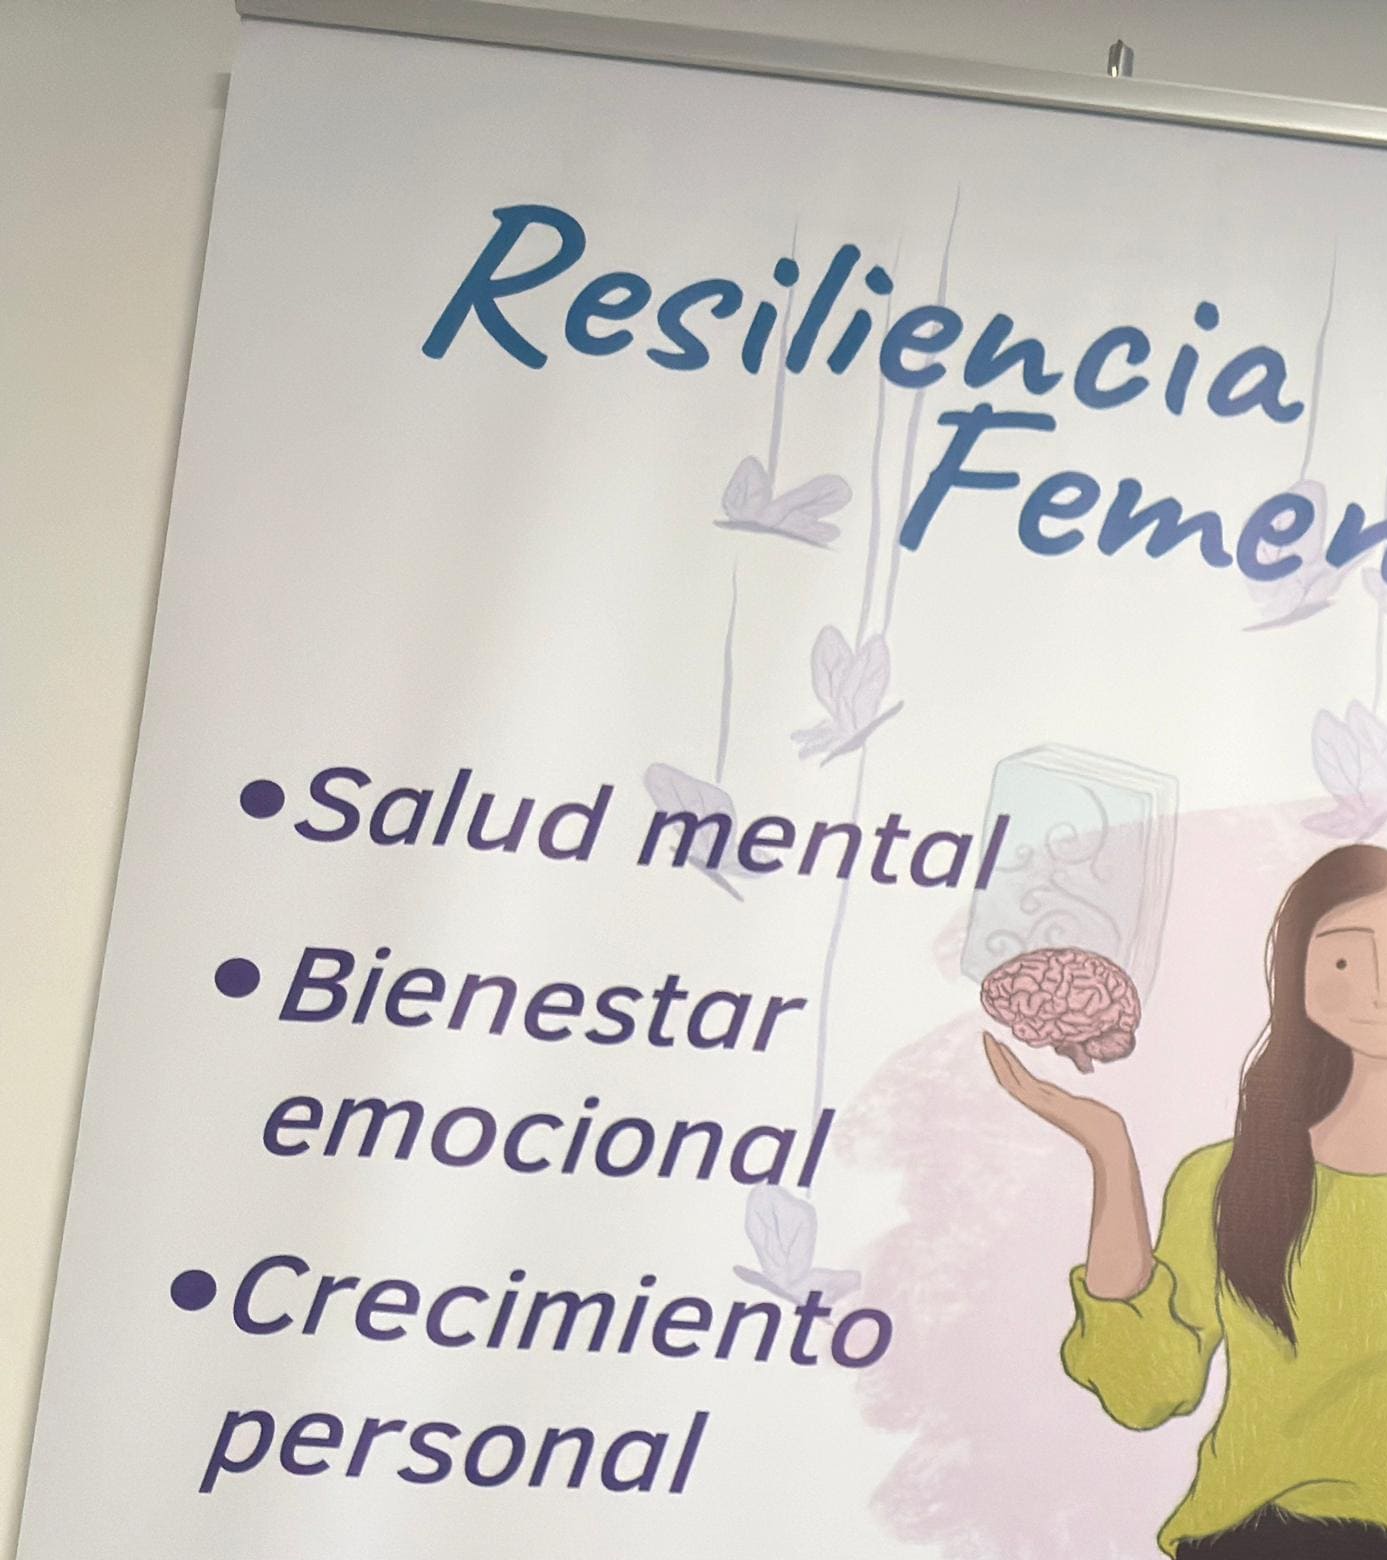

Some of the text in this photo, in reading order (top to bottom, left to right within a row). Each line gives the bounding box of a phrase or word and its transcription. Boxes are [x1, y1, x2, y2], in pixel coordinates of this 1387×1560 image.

[421, 203, 1305, 423] Resiliencia
[294, 767, 1010, 890] Salud mental
[279, 946, 807, 1053] Bienestar
[262, 1092, 836, 1188] emocional
[231, 1255, 894, 1369] Crecimiento
[198, 1406, 709, 1494] personal
